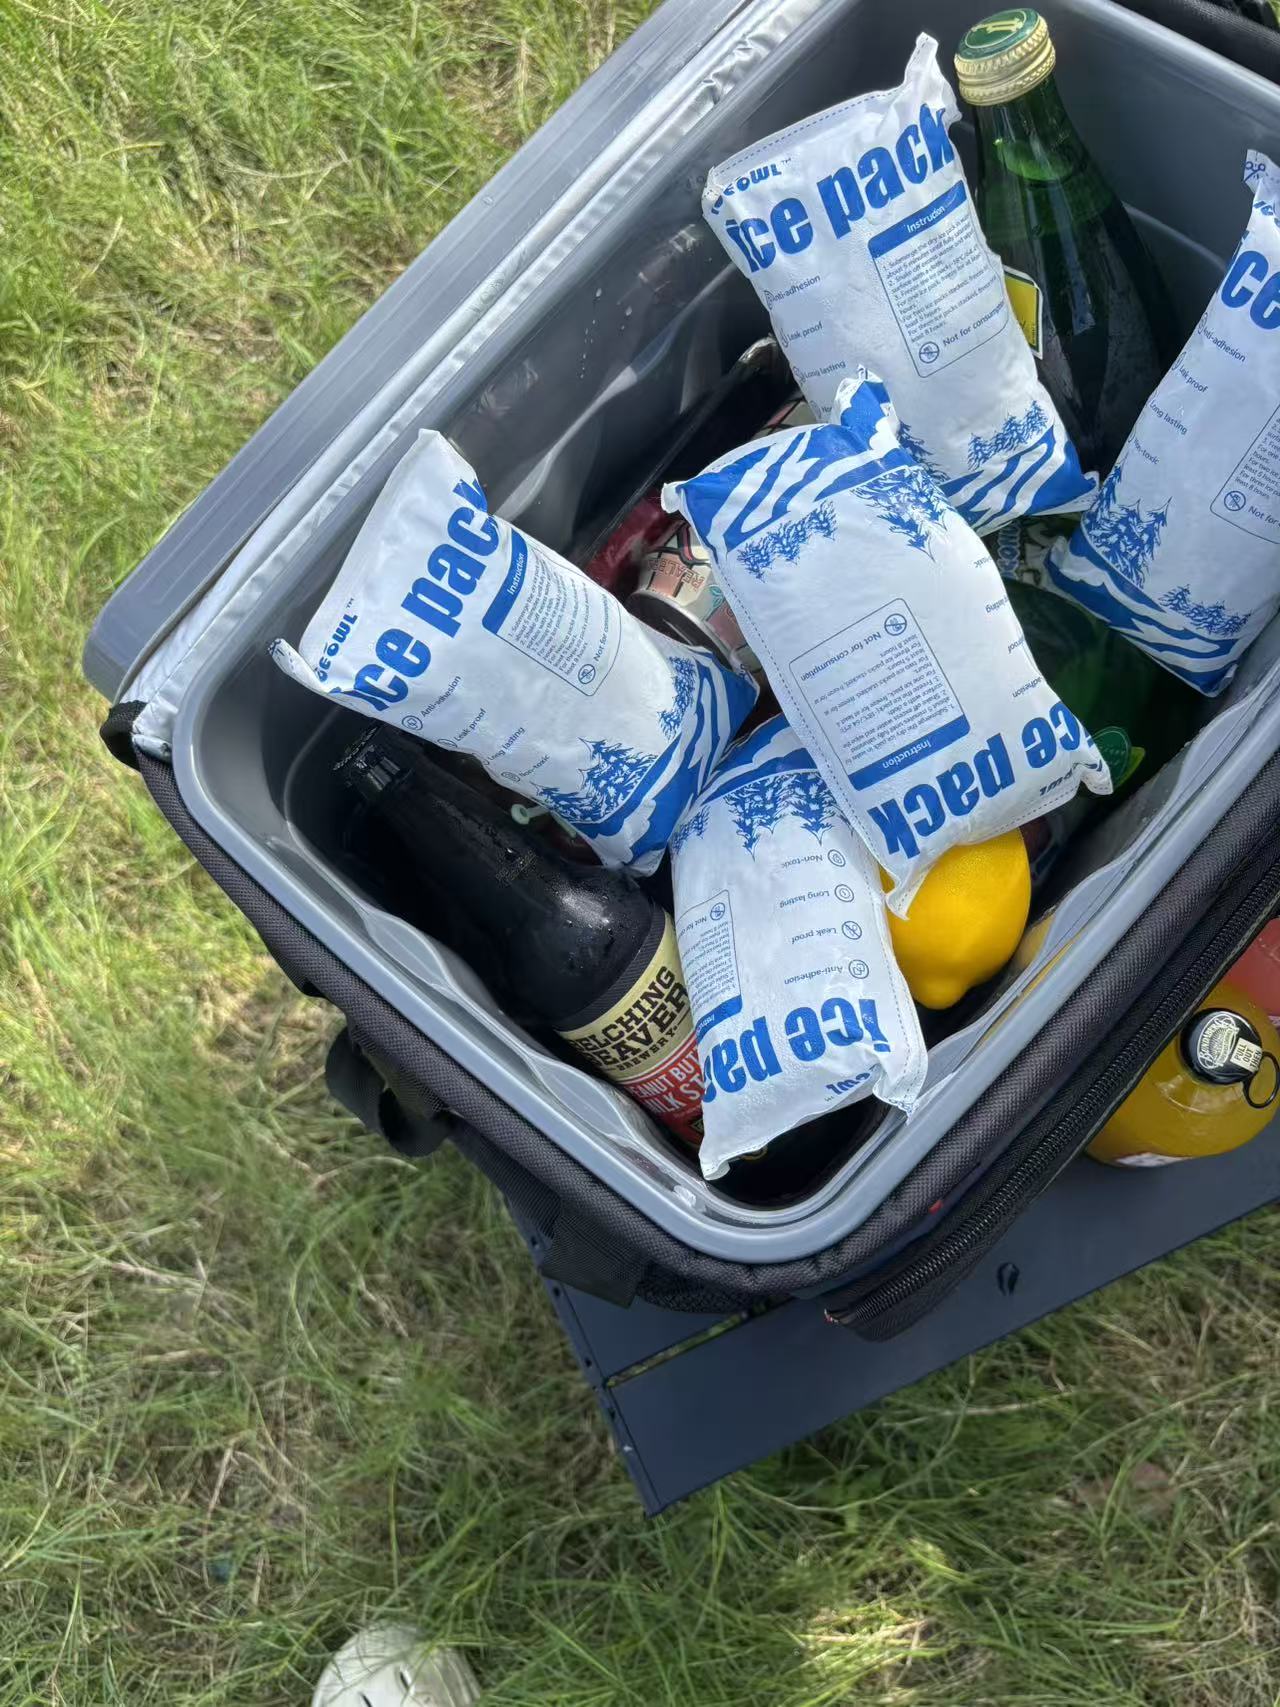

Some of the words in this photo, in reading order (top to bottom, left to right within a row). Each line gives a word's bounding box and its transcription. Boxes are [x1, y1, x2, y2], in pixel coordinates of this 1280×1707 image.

[725, 198, 813, 273] ice
[817, 103, 955, 239] pack
[1221, 248, 1280, 330] ce
[801, 321, 824, 338] proof
[943, 333, 959, 347] Not
[959, 325, 972, 337] for
[820, 358, 846, 376] lasting
[1187, 374, 1209, 395] proof
[1163, 413, 1189, 436] lasting
[1248, 505, 1265, 519] Not
[1264, 514, 1279, 527] for
[506, 553, 524, 595] Instruction
[863, 631, 881, 645] Not
[910, 640, 921, 650] For
[593, 646, 605, 662] Not
[599, 633, 609, 645] for
[850, 642, 863, 653] for
[892, 646, 910, 660] three
[799, 649, 850, 682] consumption
[883, 656, 892, 665] ice
[918, 655, 929, 664] For
[925, 668, 936, 678] For
[903, 681, 913, 690] ice
[421, 675, 462, 719] Anti-adhesion
[893, 696, 902, 705] ice
[902, 690, 913, 700] the
[907, 694, 921, 705] with
[922, 693, 940, 706] Shake
[893, 707, 913, 721] excess
[913, 703, 922, 712] off
[454, 726, 470, 743] Leak
[467, 707, 488, 730] proof
[876, 718, 893, 731] water
[502, 725, 526, 751] lasting
[864, 728, 876, 737] and
[880, 738, 932, 771] Instruction
[867, 735, 1015, 859] pack
[782, 854, 822, 868] Non-toxic
[779, 895, 806, 908] lasting
[807, 890, 829, 899] Long
[685, 923, 694, 931] for
[694, 916, 707, 925] Not
[790, 931, 814, 944] proof
[816, 927, 836, 936] Leak
[784, 966, 843, 985] Anti-adhesion
[785, 998, 890, 1062] ice
[1233, 1042, 1247, 1061] PULL
[1242, 1048, 1254, 1063] OUT
[1249, 1050, 1263, 1069] THEN
